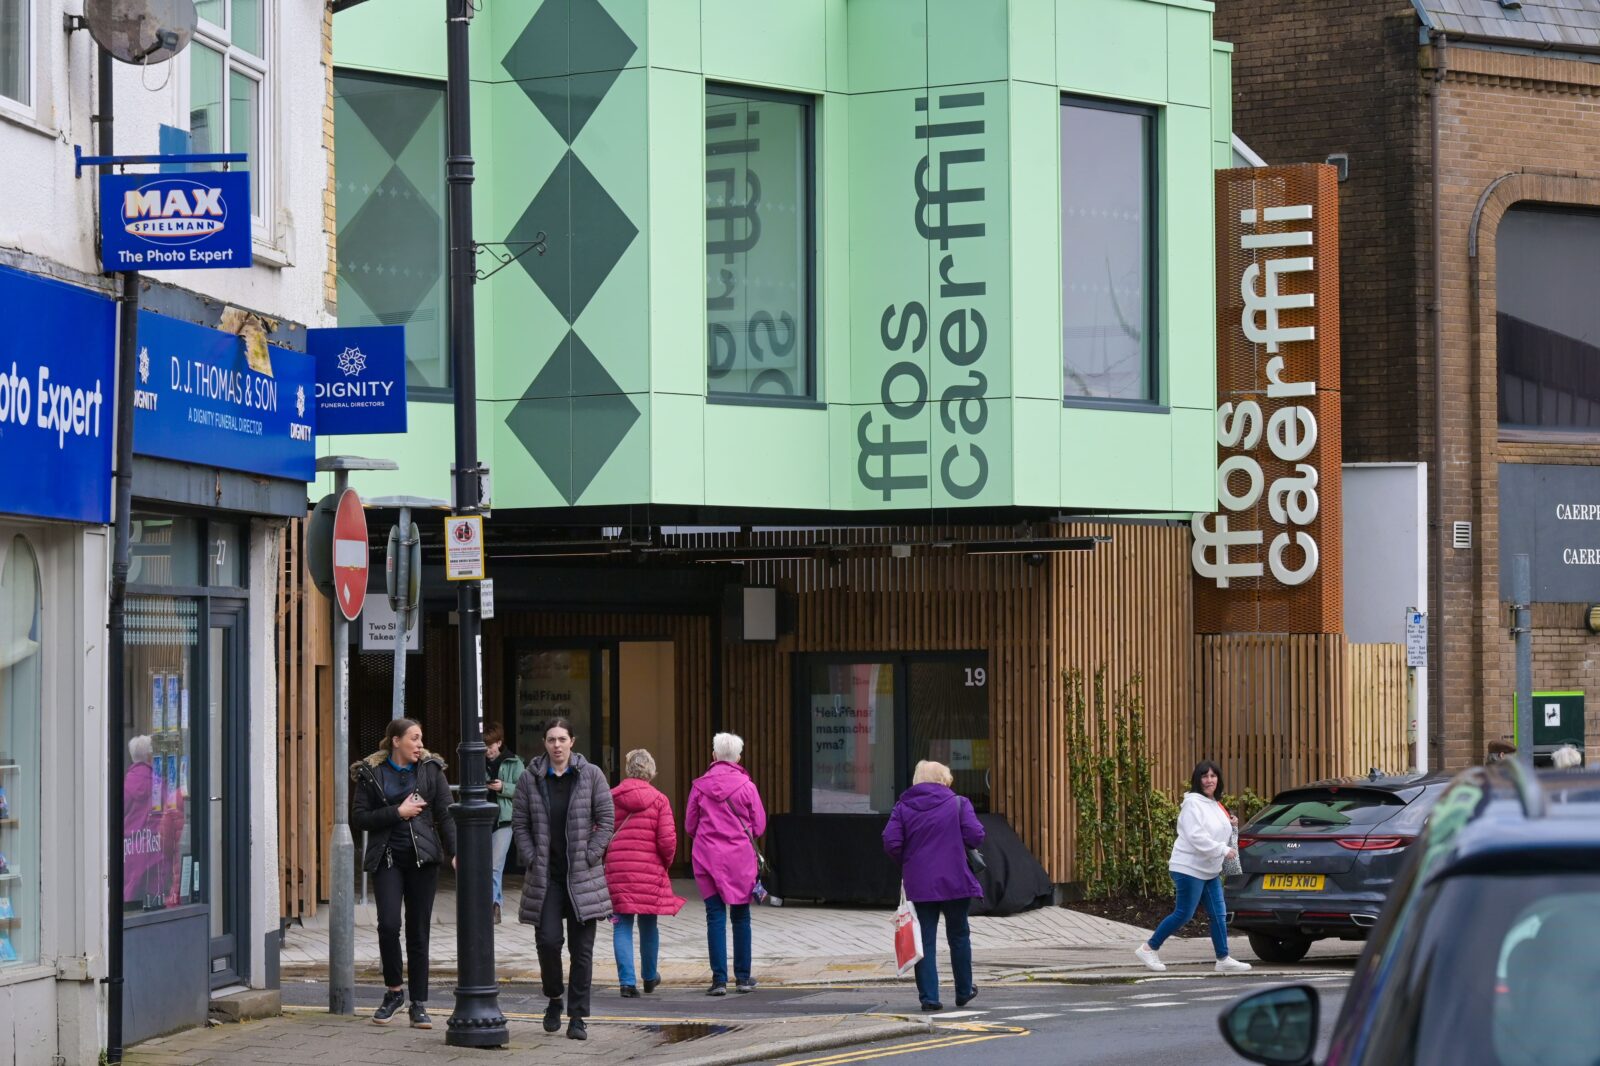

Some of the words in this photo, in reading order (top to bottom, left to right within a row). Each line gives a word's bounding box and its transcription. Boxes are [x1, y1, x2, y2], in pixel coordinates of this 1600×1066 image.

[124, 188, 224, 218] MAX
[134, 221, 215, 232] SPIELMANN
[118, 250, 143, 263] The
[146, 249, 186, 263] Photo
[189, 248, 233, 264] Expert
[914, 92, 989, 500] caerffili
[194, 362, 242, 405] THOMAS
[245, 374, 253, 408] &
[255, 377, 278, 413] SON
[315, 381, 394, 398] DIGNITY
[1240, 204, 1319, 586] caerffili
[37, 365, 103, 450] Expert
[857, 301, 929, 501] ffos
[188, 408, 193, 421] A
[193, 409, 215, 427] DIGNITY
[215, 413, 238, 431] FUNERAL
[239, 417, 263, 436] DIRECTOR
[290, 422, 312, 442] DIGNITY
[1191, 400, 1265, 588] ffos
[216, 539, 226, 566] 27
[369, 622, 386, 630] Two
[369, 632, 411, 642] Takeay
[964, 667, 986, 687] 19
[816, 739, 845, 753] yma?
[146, 828, 161, 853] Rest
[1269, 875, 1293, 888] WT19
[1296, 875, 1318, 888] XWO
